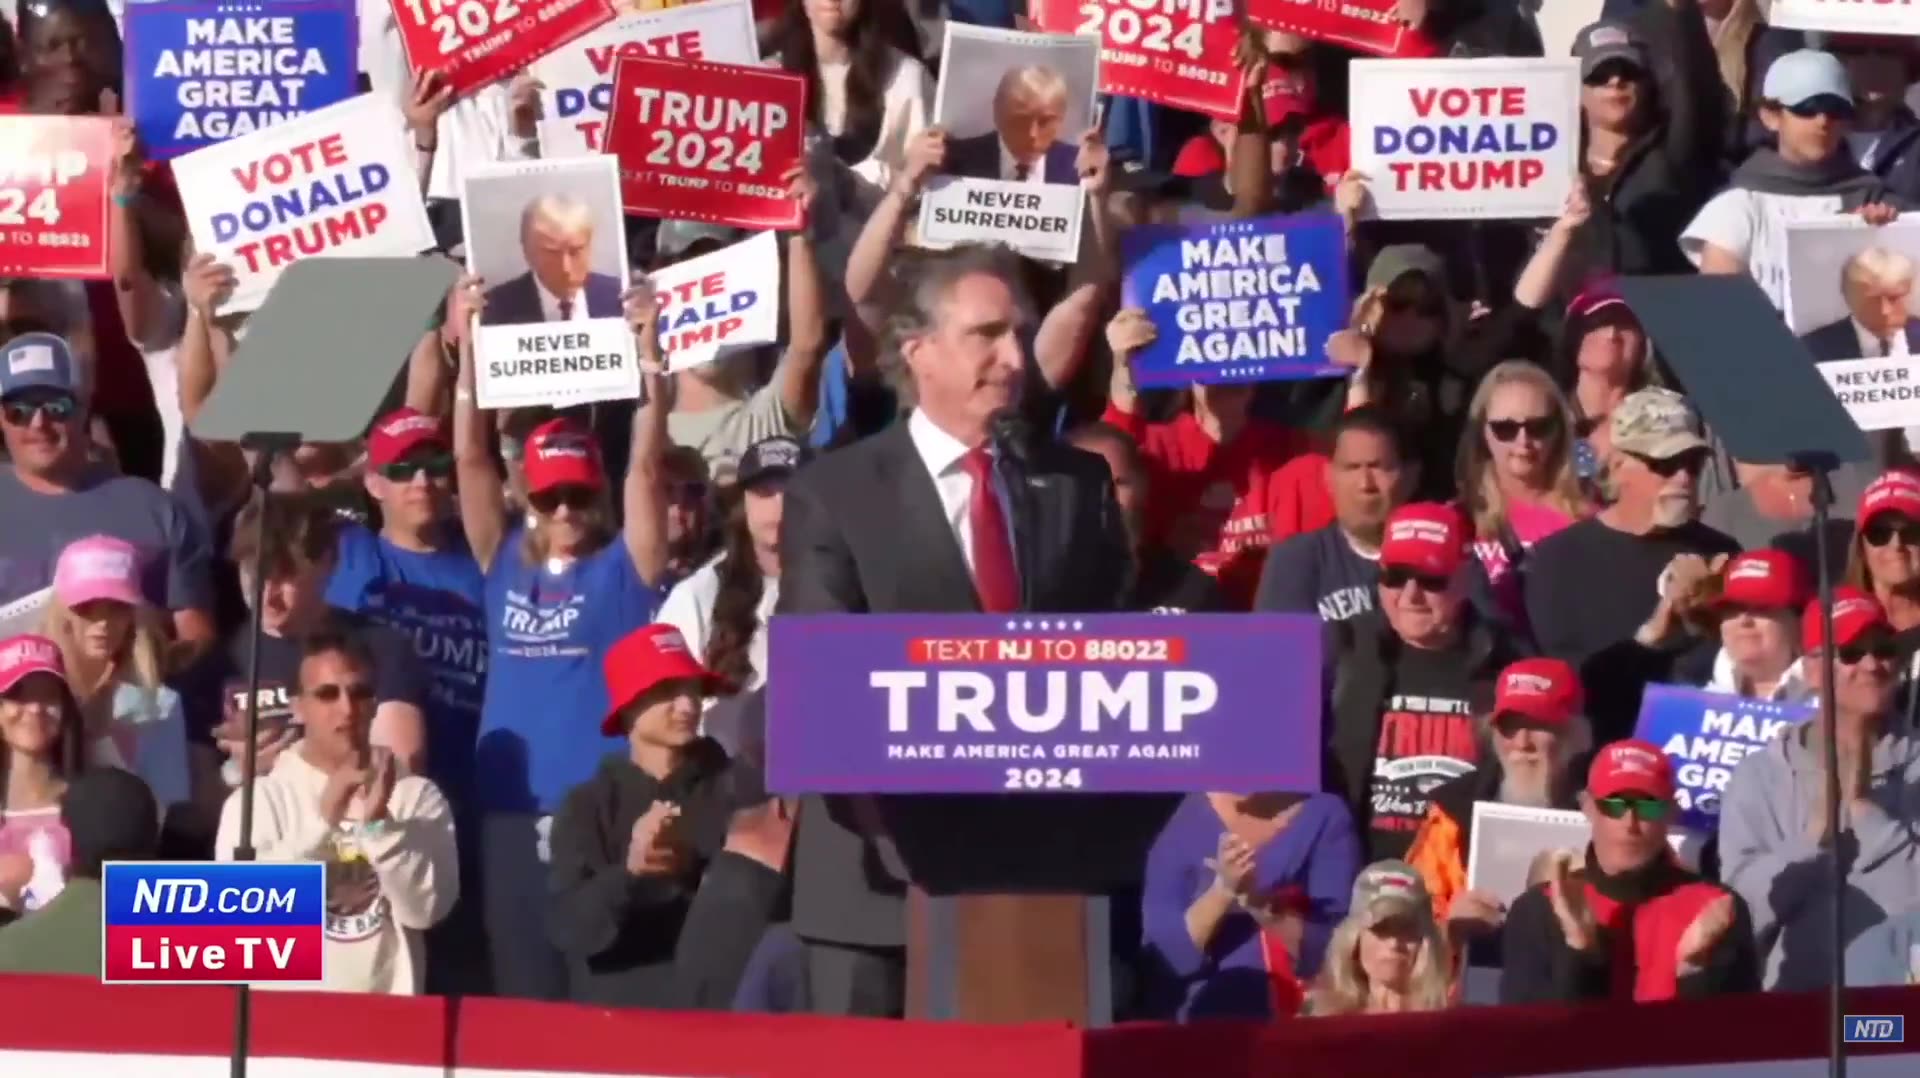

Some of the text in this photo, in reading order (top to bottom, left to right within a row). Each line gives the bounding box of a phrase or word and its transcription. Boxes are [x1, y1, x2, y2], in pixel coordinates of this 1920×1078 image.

[186, 17, 295, 45] MAKE
[431, 0, 528, 54] 202
[1075, 3, 1204, 59] 2024
[153, 47, 328, 77] AMERICA
[177, 79, 305, 108] GREAT
[1408, 87, 1526, 118] VOTE
[173, 111, 307, 139] AGAI
[634, 87, 788, 138] TRUMP
[646, 130, 762, 175] 2024
[1373, 122, 1559, 155] DONALD
[231, 133, 348, 194] VOTE
[1387, 159, 1544, 192] TRUMP
[659, 173, 709, 189] TRUMP
[715, 180, 733, 193] TO
[967, 188, 1042, 210] NEVER
[210, 162, 390, 243] DONALD
[935, 207, 1068, 233] SURRENDER
[234, 202, 388, 273] TRUMP
[1181, 233, 1287, 269] MAKE
[1152, 263, 1321, 304] AMERICA
[1175, 297, 1301, 332] GREAT
[518, 332, 591, 353] NEVER
[1175, 327, 1307, 365] AGAIN!
[490, 353, 623, 379] SURRENDER
[1836, 367, 1910, 386] NEVER
[1838, 384, 1920, 404] RRENDE
[923, 639, 1169, 661] TEXT NJ TO 88022
[869, 670, 1219, 733] TRUMP
[1377, 711, 1478, 760] TRUM
[1701, 708, 1788, 742] MAK
[887, 744, 1201, 759] MAKE AMERICA GREAT AGAIN!
[1004, 767, 1083, 789] 2024
